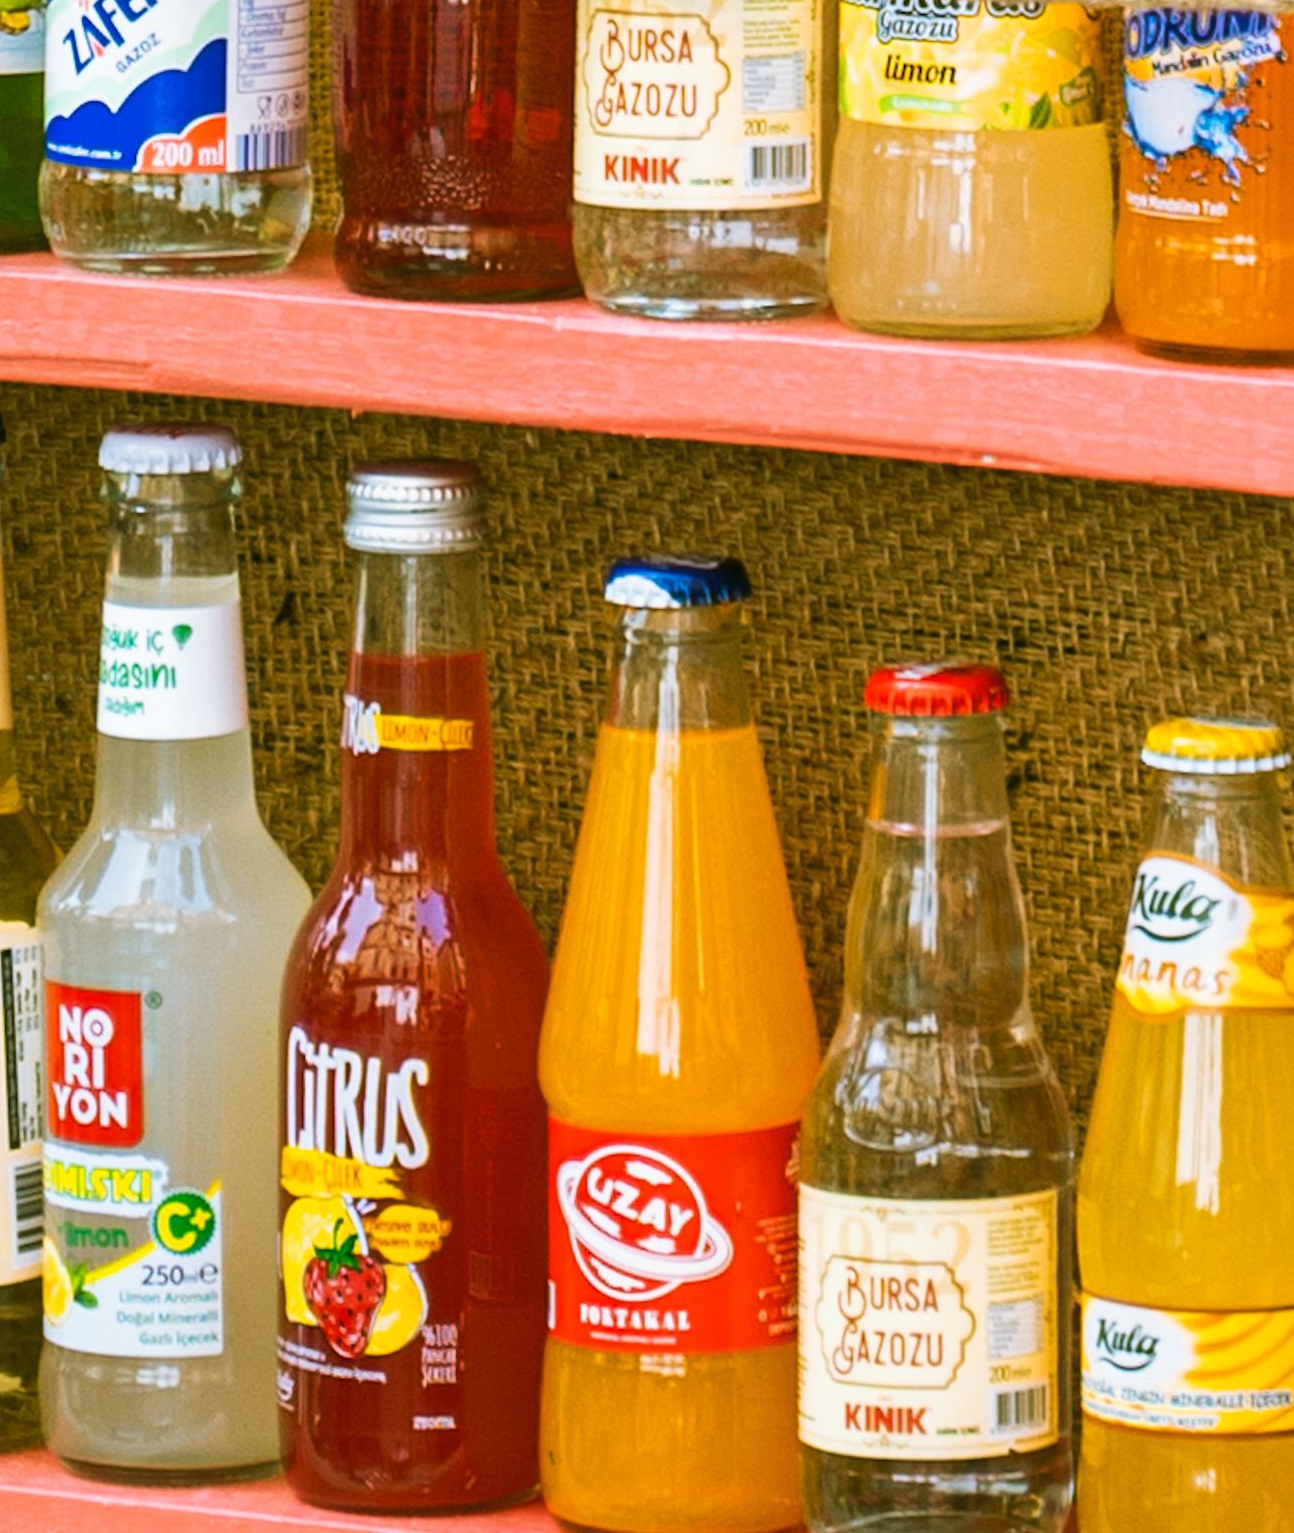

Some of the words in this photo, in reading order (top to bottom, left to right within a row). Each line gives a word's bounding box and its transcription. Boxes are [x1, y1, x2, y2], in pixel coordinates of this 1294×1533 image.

[115, 32, 162, 74] GAZOZ
[599, 18, 693, 74] BURSA
[884, 52, 957, 84] limon
[594, 73, 698, 127] GAZOZU
[743, 118, 767, 136] 200
[151, 142, 193, 167] 200
[198, 139, 224, 166] ml
[604, 154, 681, 185] KINIK
[146, 628, 164, 656] iç
[1131, 873, 1221, 923] Kula
[59, 1003, 115, 1048] NO
[63, 1041, 105, 1090] RI
[52, 1080, 129, 1129] YON
[586, 1167, 695, 1237] UZAY
[118, 1289, 161, 1305] Limon
[164, 1289, 218, 1305] Aromalı
[837, 1266, 939, 1322] BURSA
[116, 1310, 156, 1327] Doğal
[158, 1309, 218, 1325] Mineralli
[579, 1303, 691, 1331] PORTAKAL
[138, 1329, 173, 1346] Gazlı
[421, 1322, 459, 1347] %100
[833, 1321, 944, 1375] GAZOZU
[1096, 1318, 1161, 1357] Kula
[989, 1366, 1011, 1383] 200
[844, 1403, 927, 1435] KINIK
